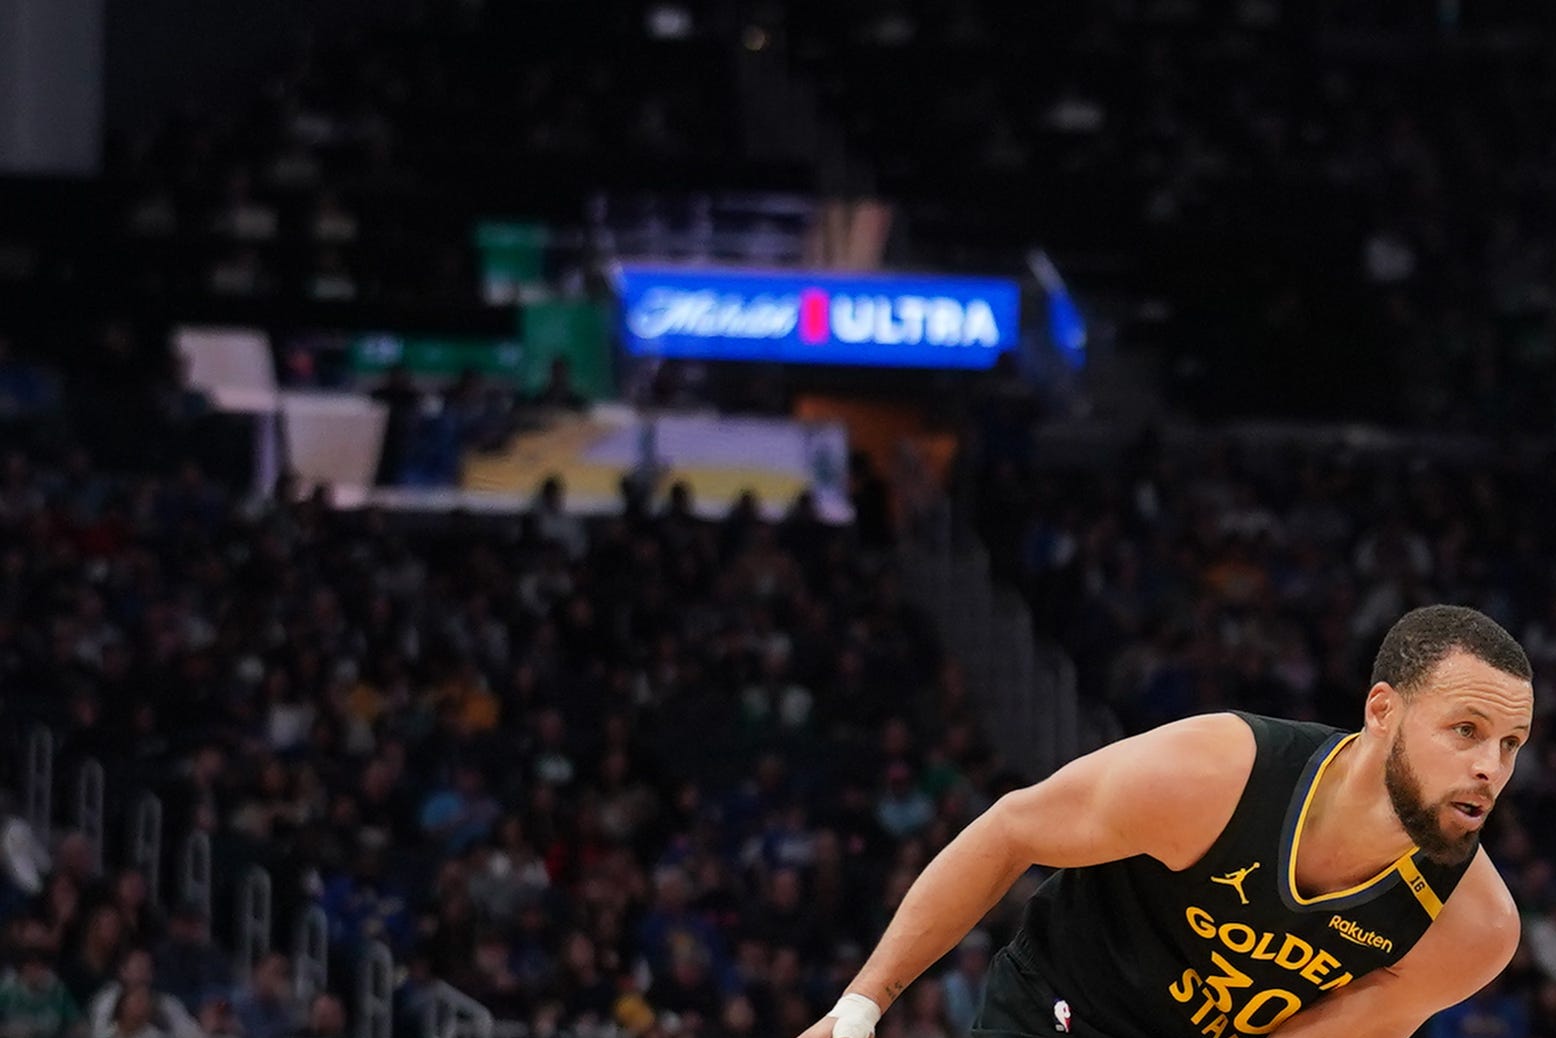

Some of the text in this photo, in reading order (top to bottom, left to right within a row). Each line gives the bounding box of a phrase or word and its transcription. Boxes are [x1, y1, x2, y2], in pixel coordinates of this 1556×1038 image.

[832, 294, 1001, 348] ULTRA
[1329, 914, 1393, 953] Rakuten
[1205, 951, 1301, 1035] 30
